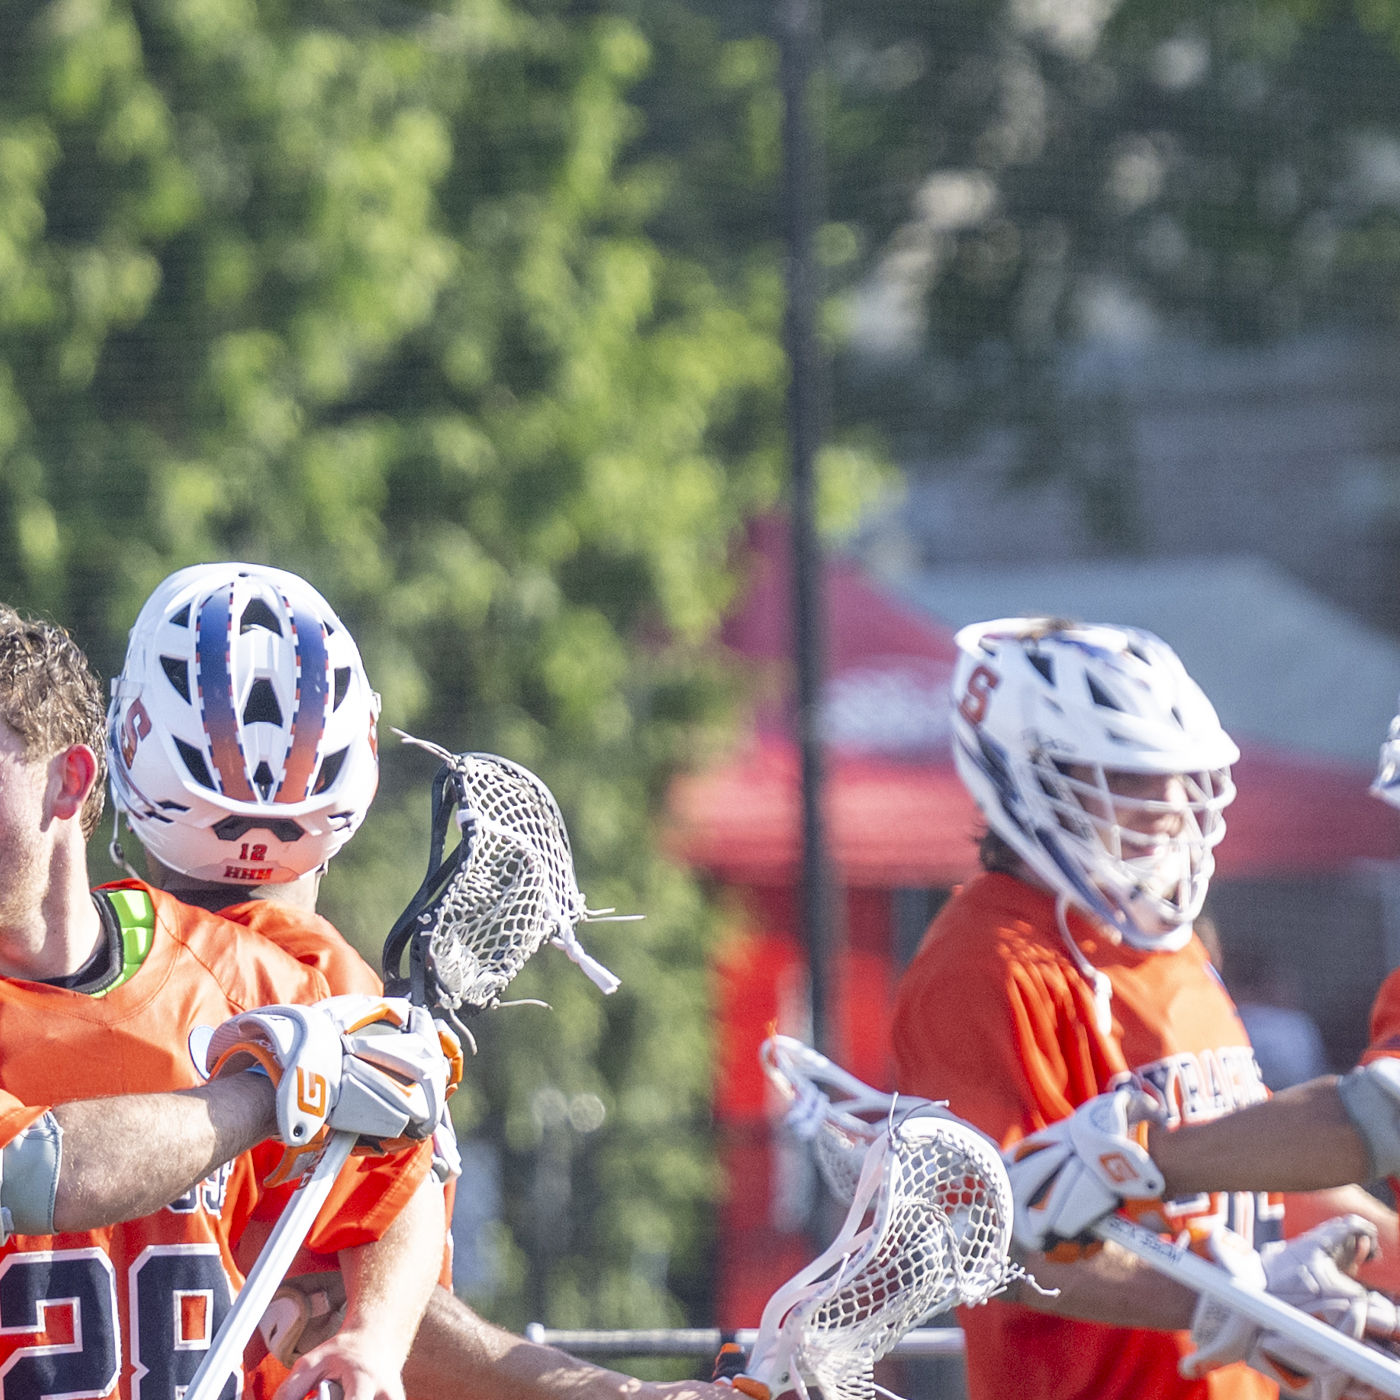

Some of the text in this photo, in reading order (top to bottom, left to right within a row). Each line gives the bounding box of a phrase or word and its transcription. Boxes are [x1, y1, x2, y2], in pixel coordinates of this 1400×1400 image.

[958, 664, 1000, 725] S
[238, 843, 269, 861] 12
[223, 864, 274, 881] HHH
